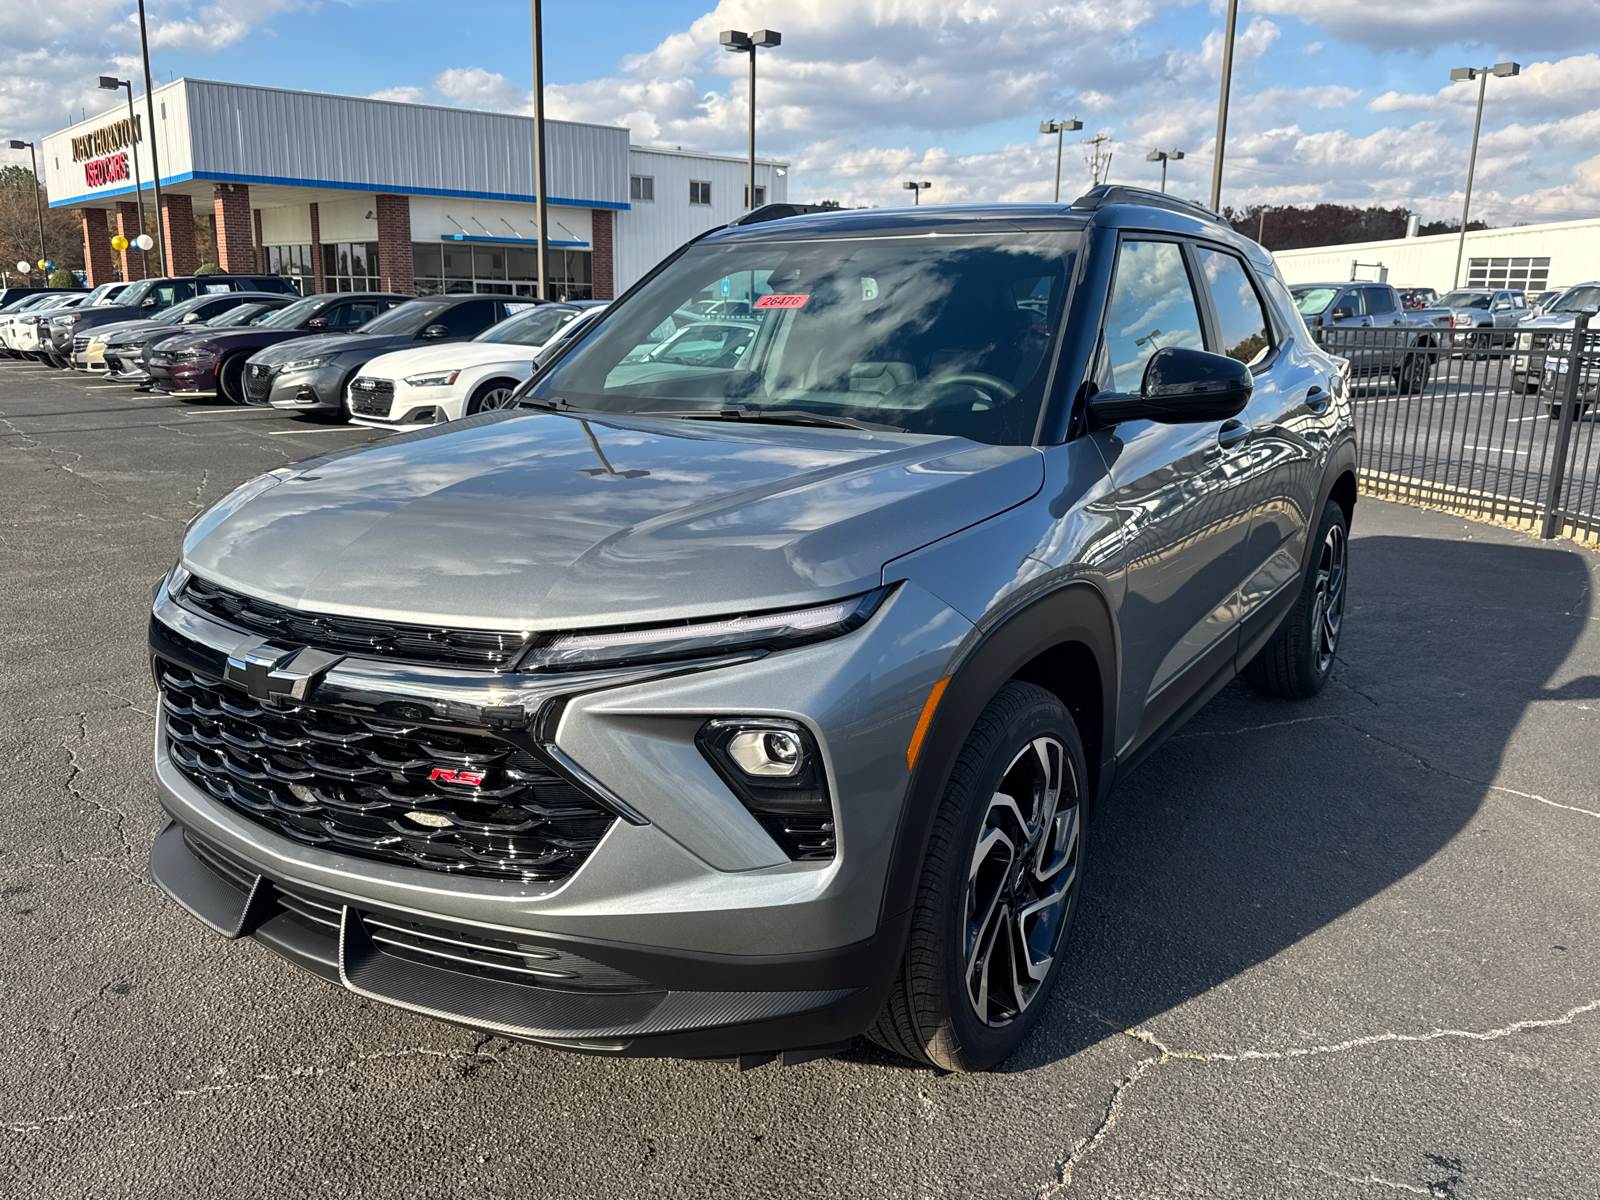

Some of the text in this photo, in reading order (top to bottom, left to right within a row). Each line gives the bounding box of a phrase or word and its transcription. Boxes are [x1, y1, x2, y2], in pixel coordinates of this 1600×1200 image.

[72, 115, 142, 162] JOHN THORNTON
[84, 152, 129, 187] USED CARS
[762, 296, 801, 306] 26476
[428, 768, 485, 786] RS
